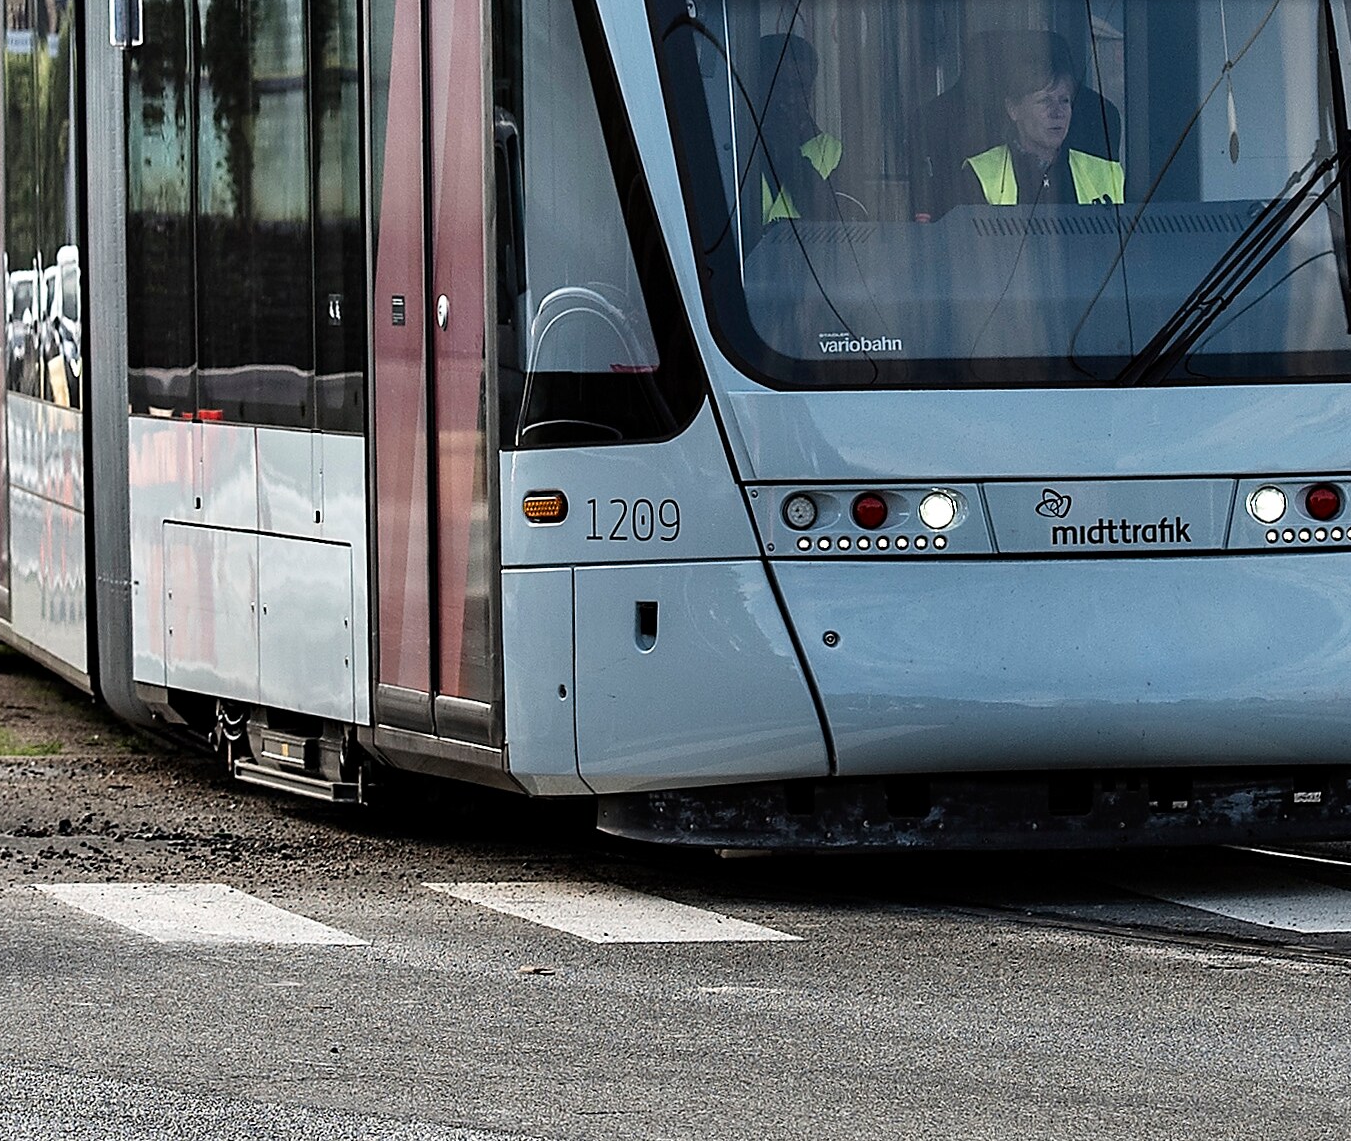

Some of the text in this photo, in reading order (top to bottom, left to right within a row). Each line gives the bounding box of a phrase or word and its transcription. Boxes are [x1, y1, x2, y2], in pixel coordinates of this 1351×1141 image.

[819, 336, 903, 353] variobahn
[585, 497, 682, 543] 1209
[1052, 516, 1192, 545] midttrafik
